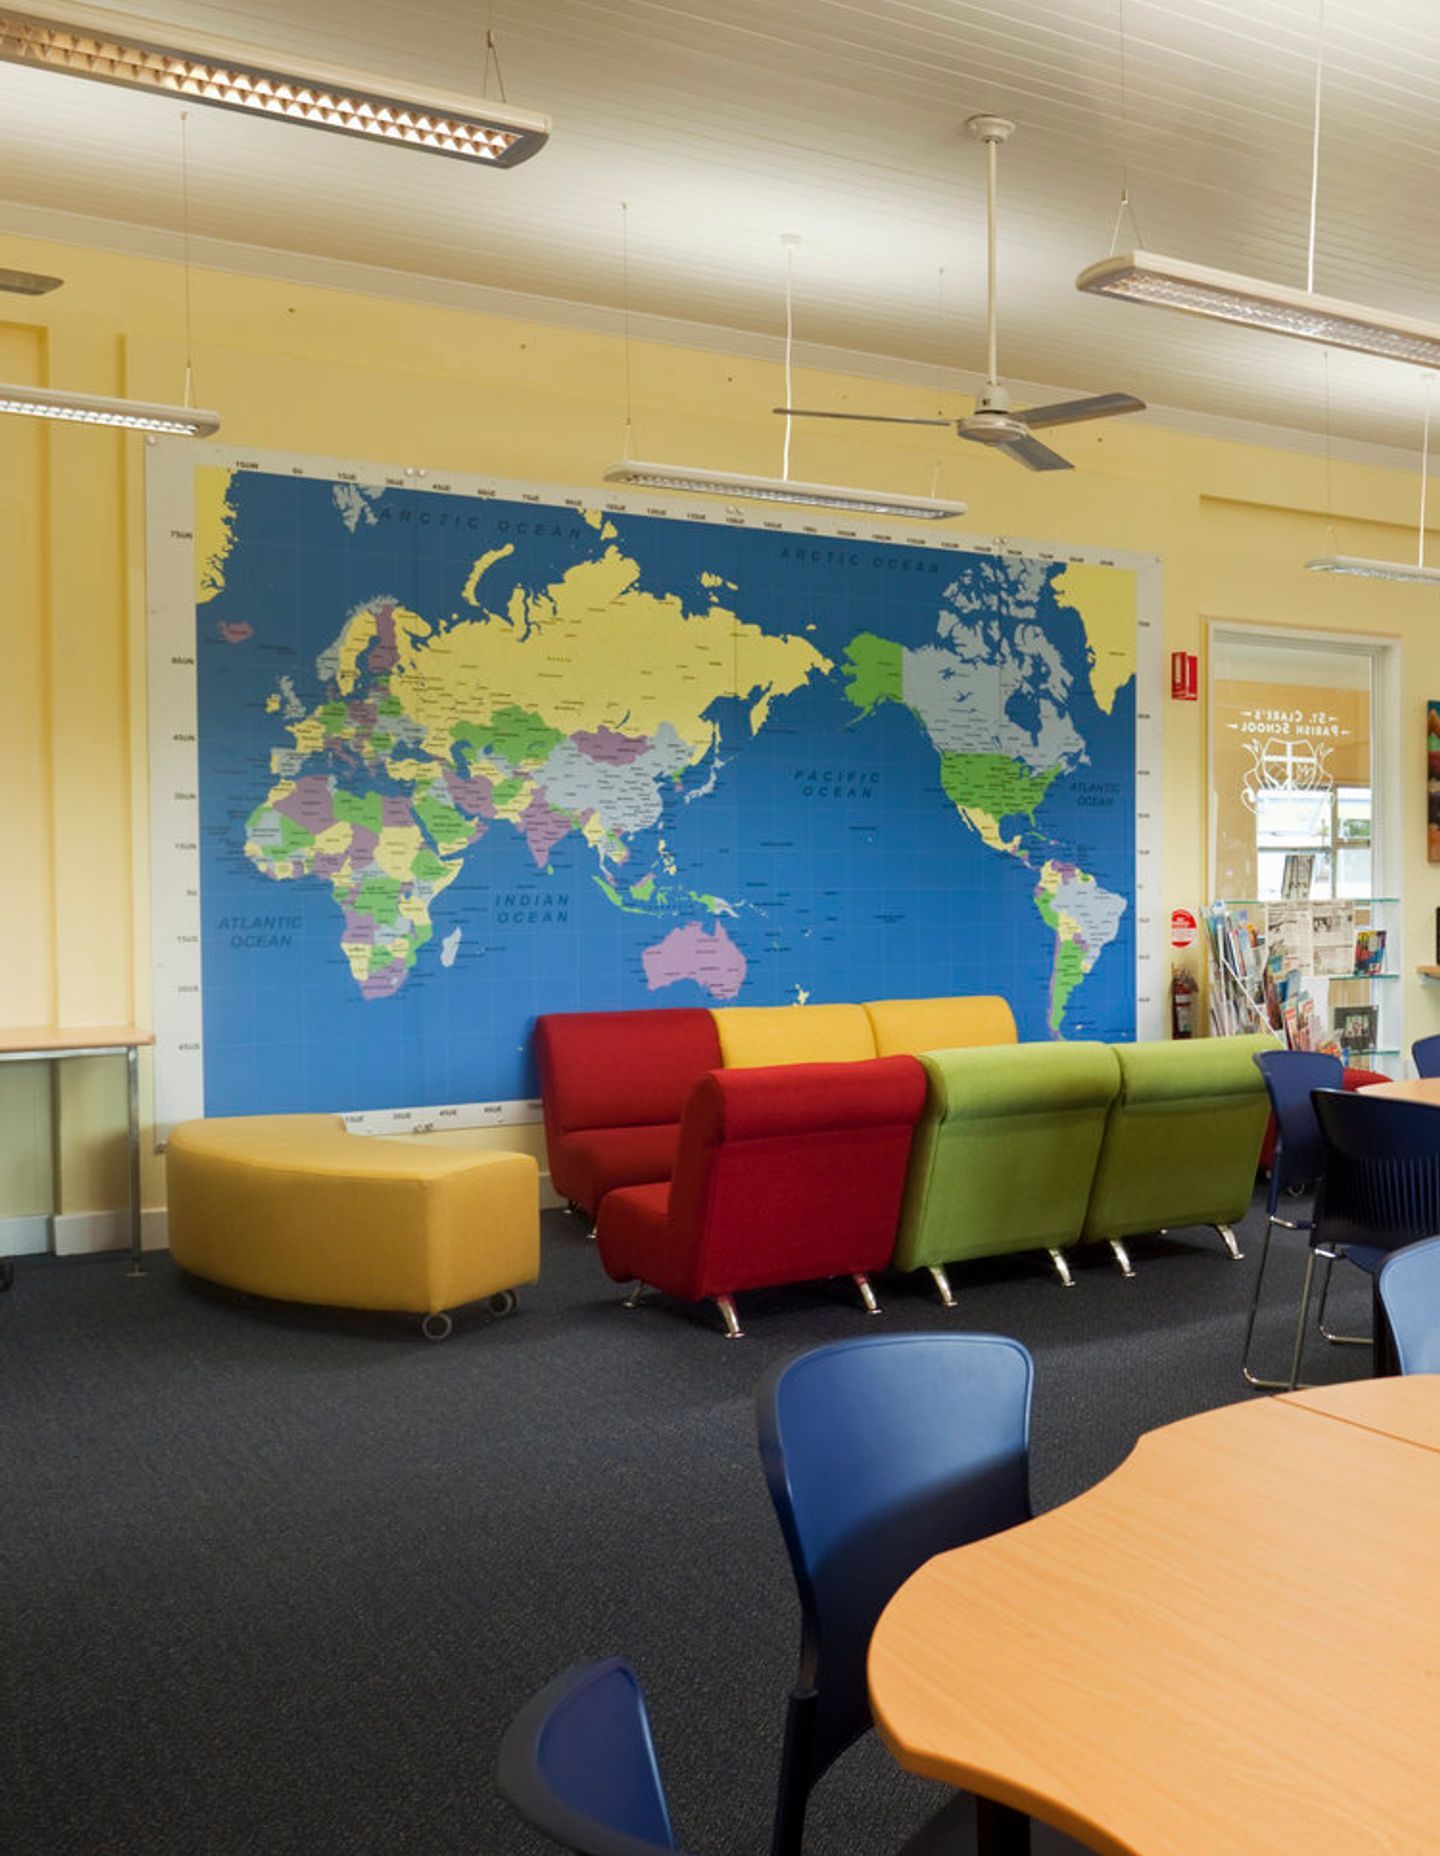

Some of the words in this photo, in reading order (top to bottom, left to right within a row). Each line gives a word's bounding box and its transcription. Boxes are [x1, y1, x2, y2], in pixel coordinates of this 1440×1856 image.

[380, 506, 479, 530] ARCTIC
[497, 519, 582, 540] OCEAN
[781, 548, 859, 567] ARCTIC
[872, 556, 939, 574] OCEAN
[793, 768, 880, 785] PACIFIC
[803, 784, 874, 799] OCEAN
[1069, 781, 1120, 796] ATLANTIC
[1076, 795, 1115, 807] OCEAN
[495, 893, 569, 908] INDIAN
[218, 914, 303, 932] ATLANTIC
[497, 910, 569, 925] OCEAN
[230, 934, 292, 949] OCEAN
